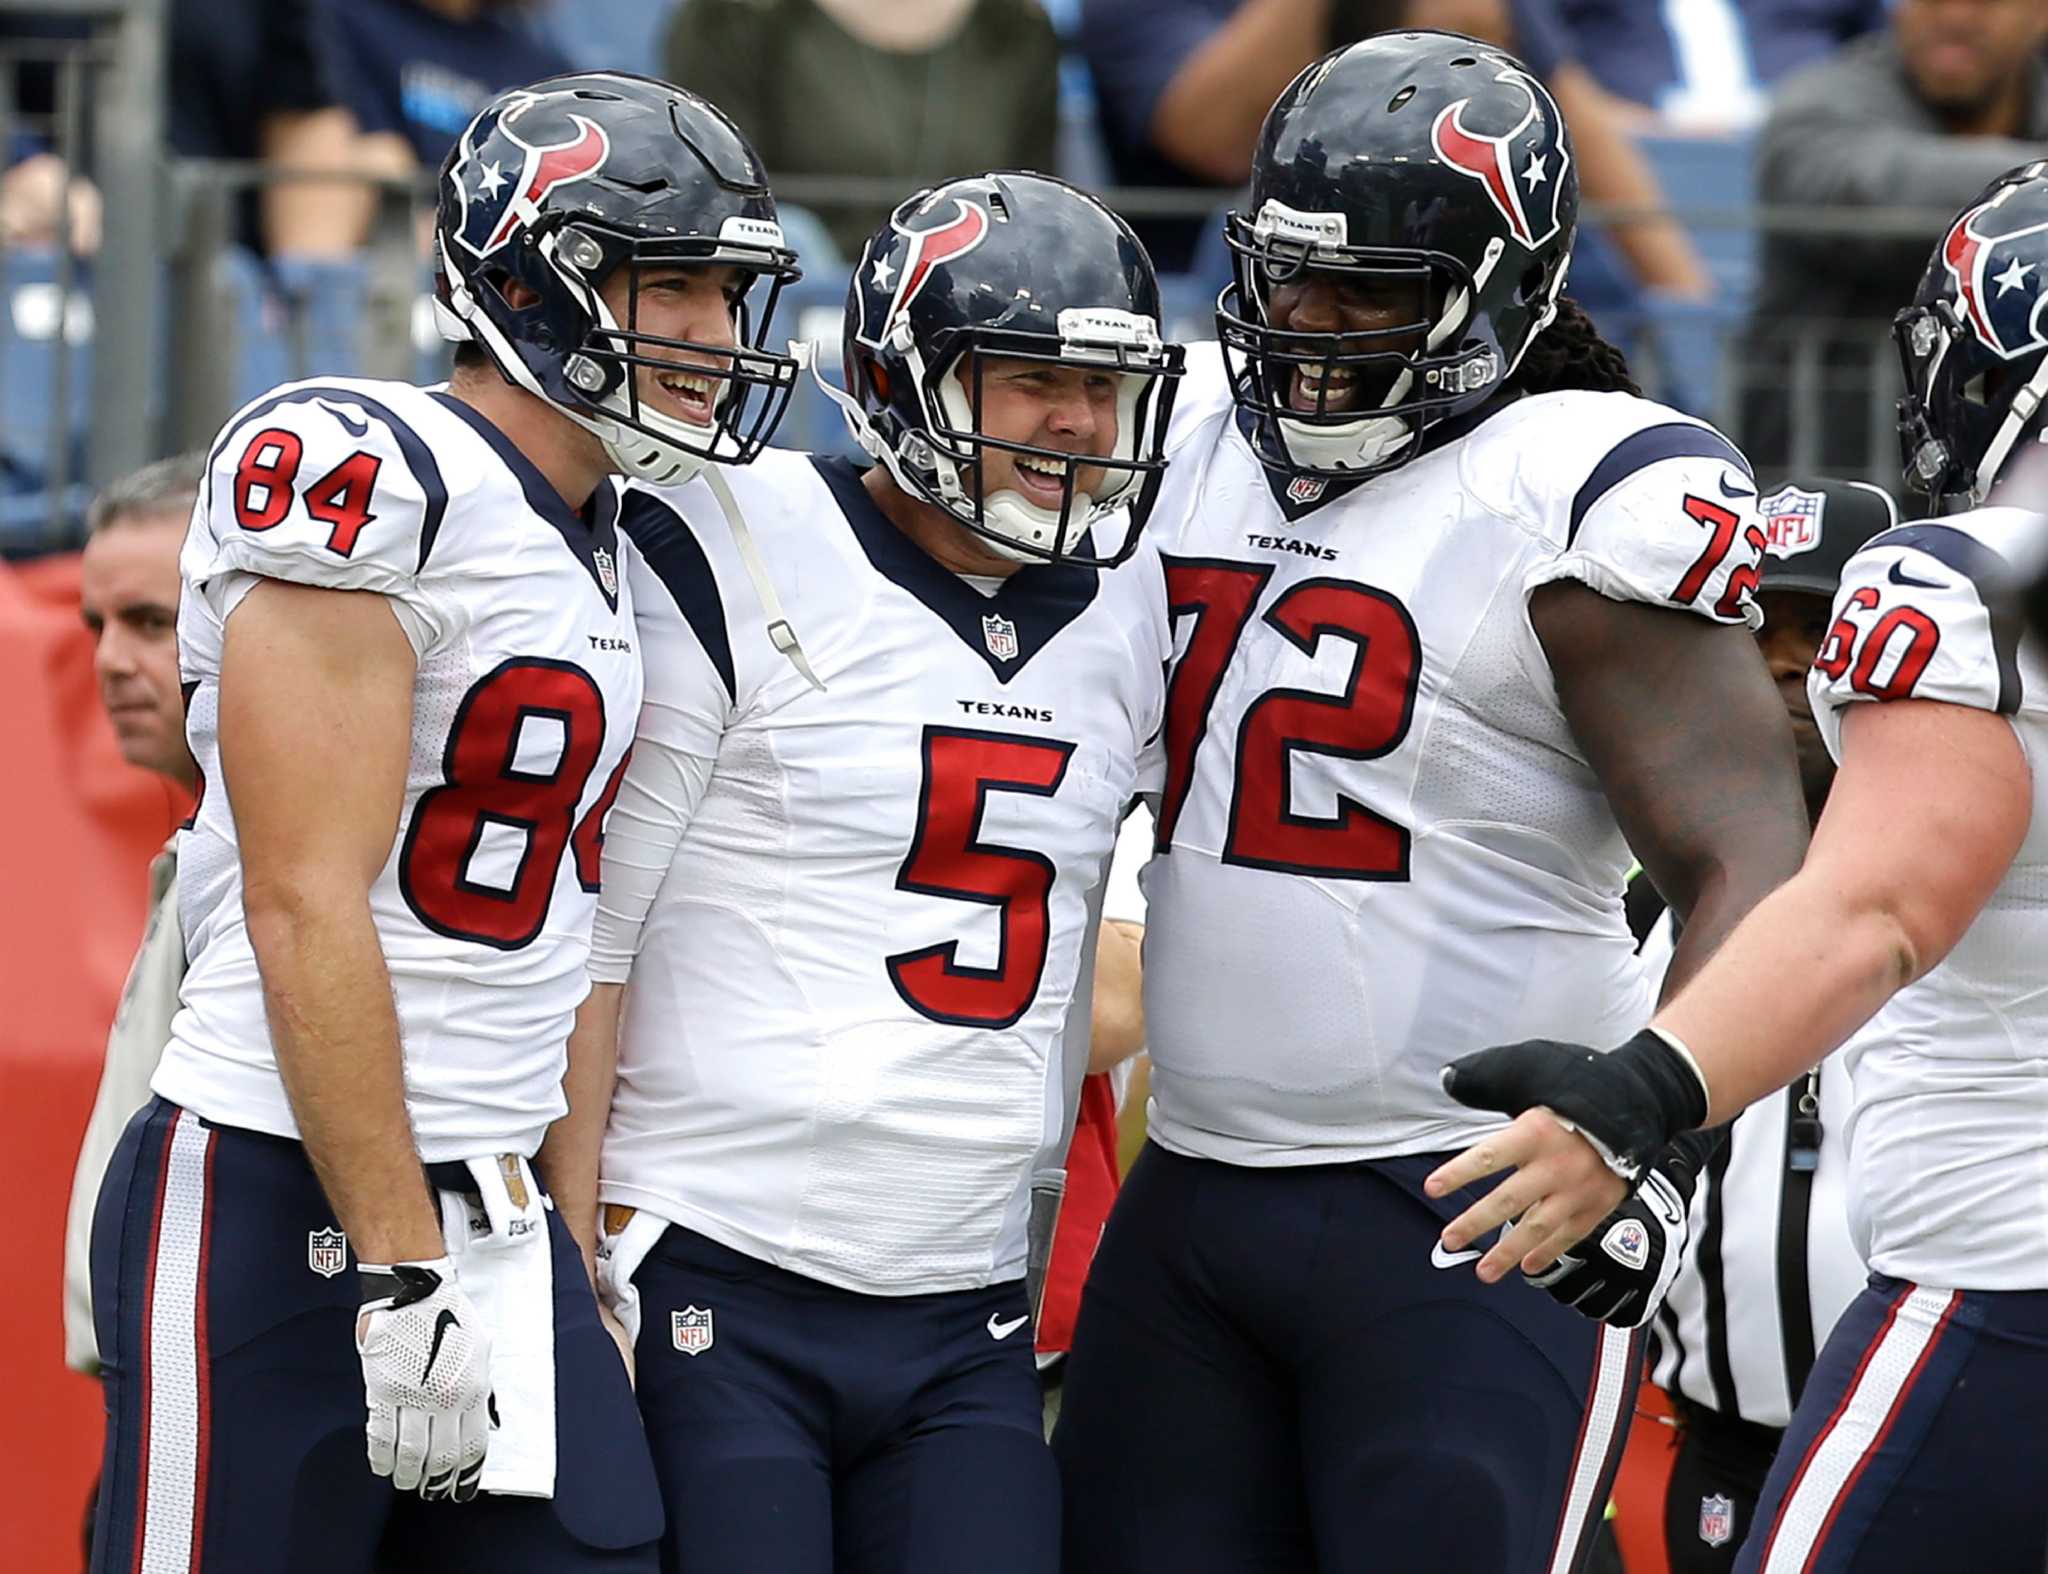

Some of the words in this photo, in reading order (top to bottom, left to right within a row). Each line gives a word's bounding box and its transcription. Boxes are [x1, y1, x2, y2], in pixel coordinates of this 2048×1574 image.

[738, 223, 779, 237] TEXANS
[1277, 215, 1321, 232] TEXANS
[1085, 318, 1132, 330] TEXANS
[234, 427, 382, 559] 84
[1294, 479, 1322, 498] NFL
[1766, 514, 1810, 548] NFL
[1246, 533, 1341, 562] TEXANS
[1668, 492, 1768, 619] 72
[989, 634, 1016, 656] NFL
[1814, 586, 1941, 702] 60
[955, 699, 1054, 722] TEXANS
[1156, 551, 1422, 882] 72
[885, 723, 1079, 1030] 5
[314, 1249, 342, 1269] NFL
[679, 1327, 708, 1347] NFL
